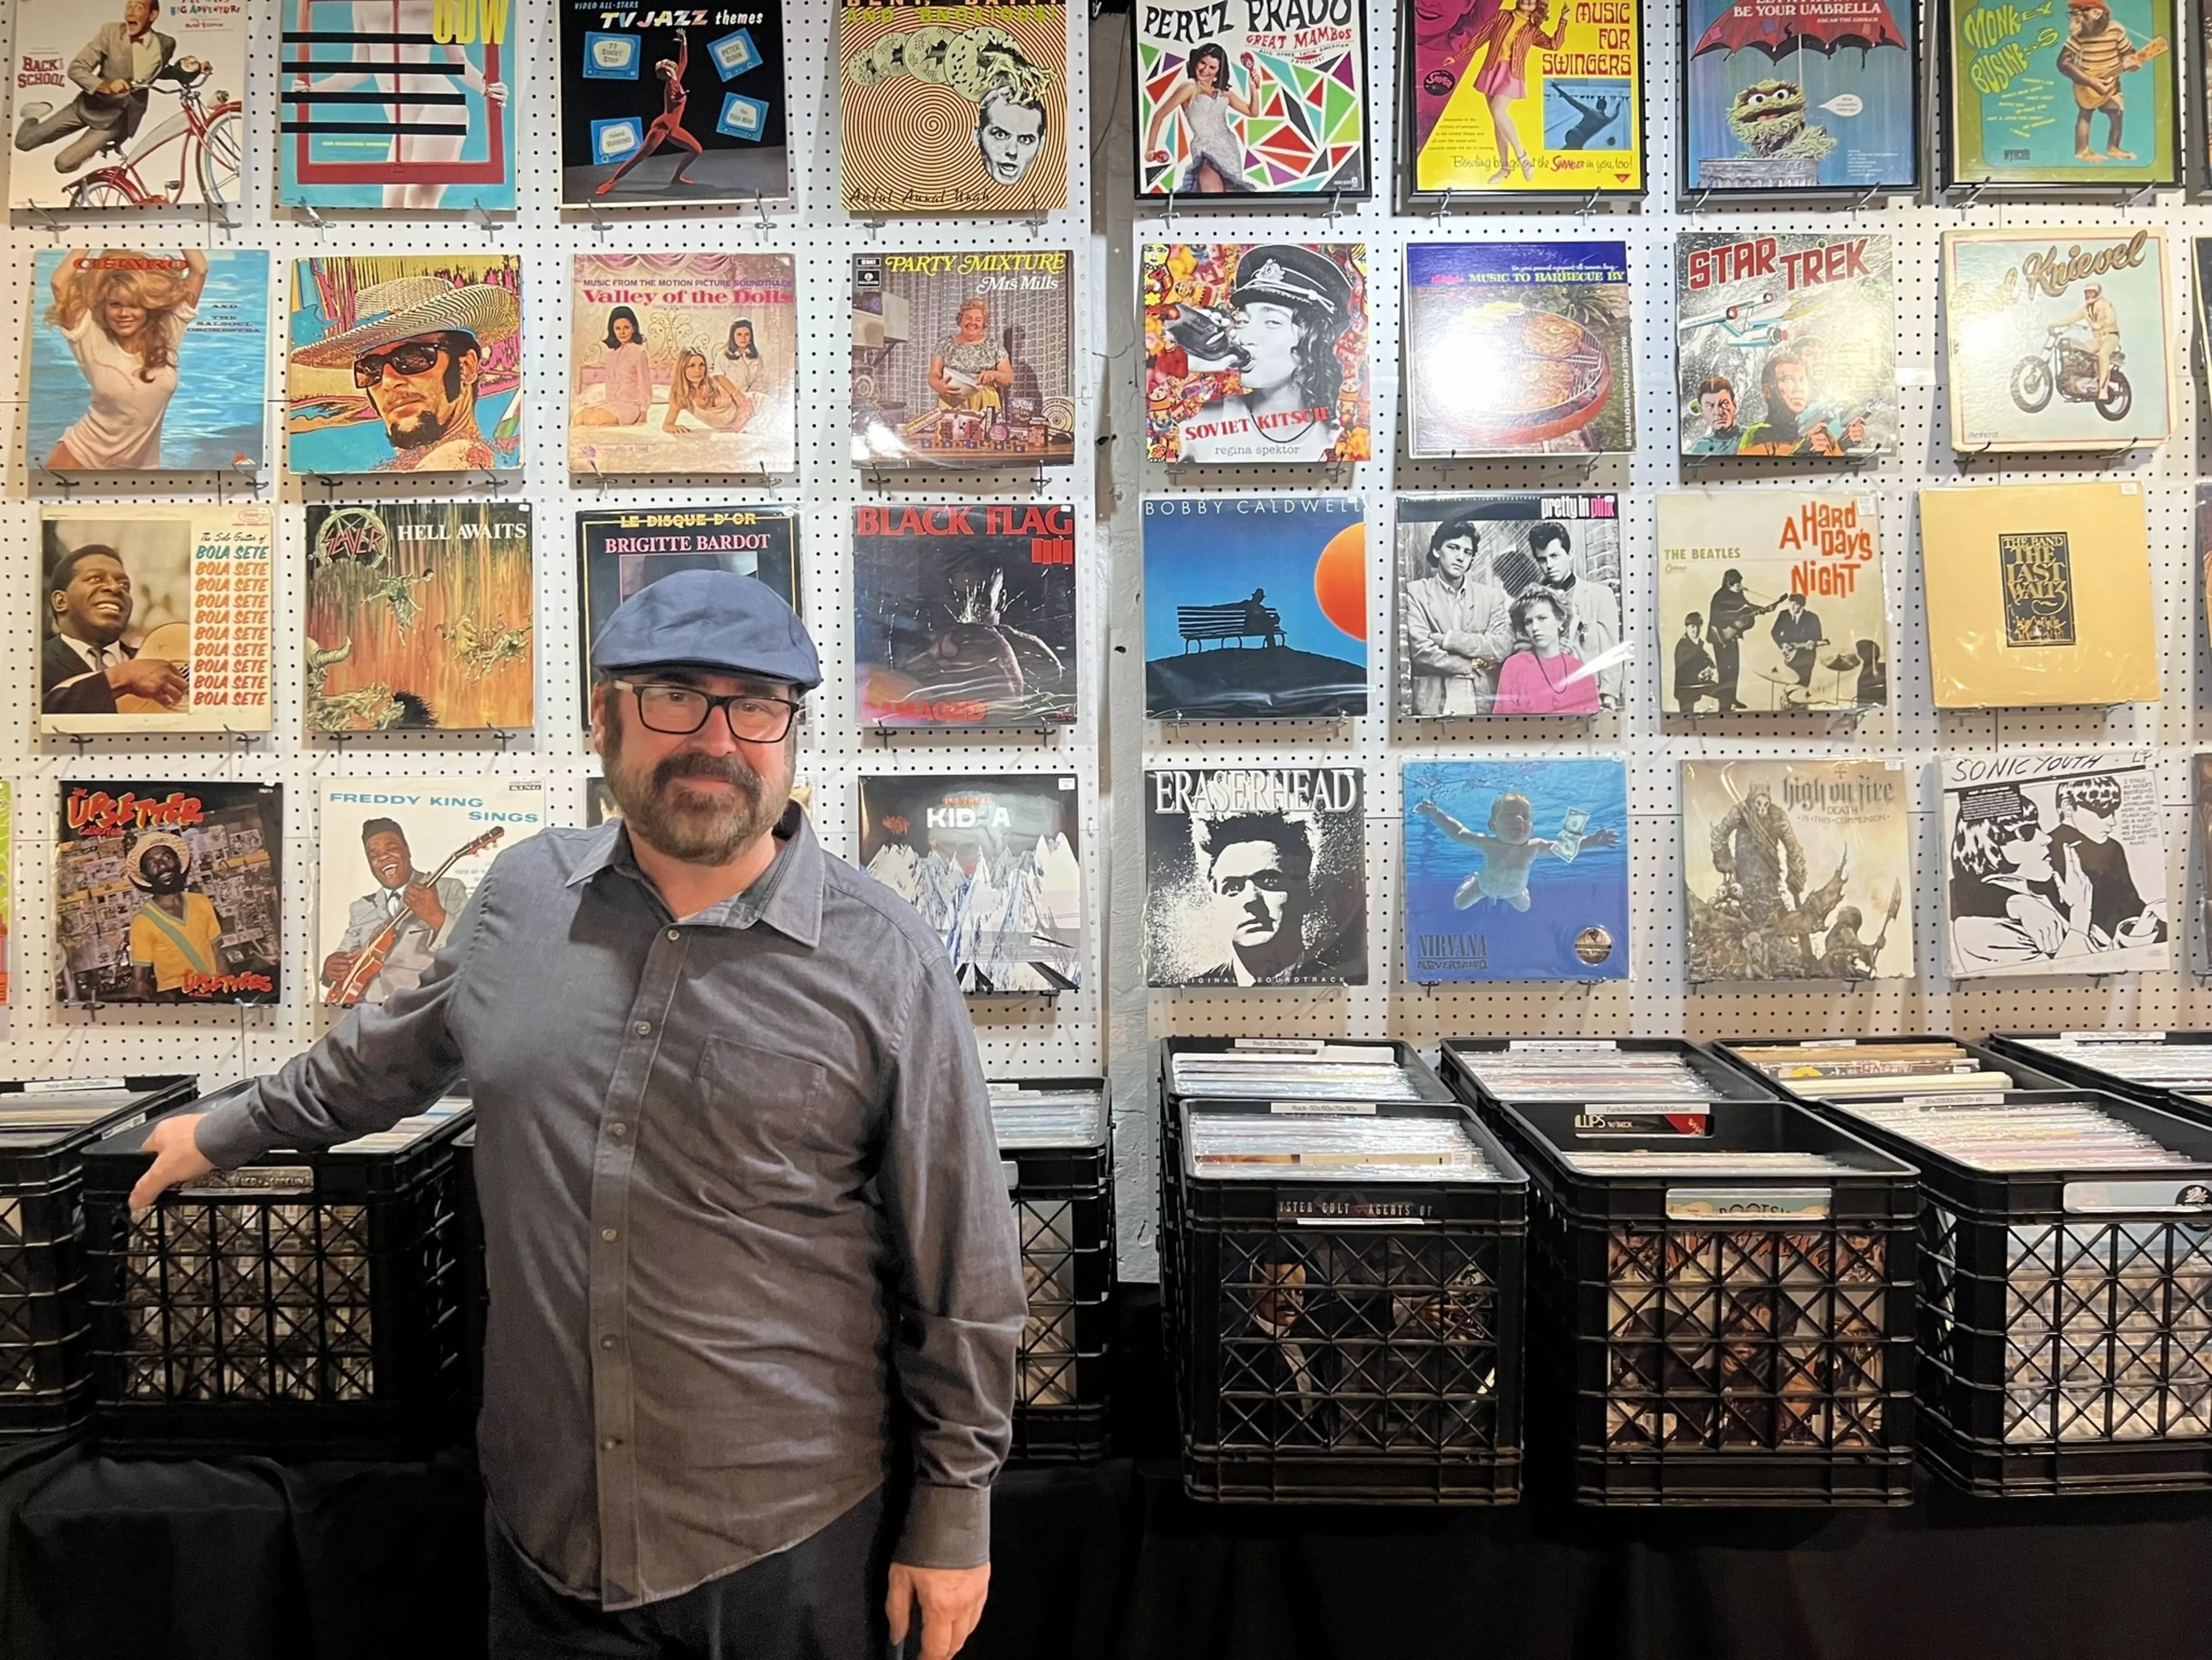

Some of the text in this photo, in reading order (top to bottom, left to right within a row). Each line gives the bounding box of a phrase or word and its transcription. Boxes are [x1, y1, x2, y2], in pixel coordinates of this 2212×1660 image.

[171, 5, 241, 16] BIG ADVENTURE
[600, 9, 763, 28] TV JAZZ themes
[846, 8, 894, 24] AND
[1575, 2, 1630, 24] MUSIC
[1734, 3, 1881, 17] BE YOUR UMBRELLA
[1143, 0, 1351, 44] PEREZ PRADO
[1964, 0, 2053, 48] MONKEY
[1246, 26, 1352, 50] GREAT MAMBOS
[1599, 29, 1630, 50] FOR
[22, 56, 58, 72] BACK
[1543, 54, 1631, 75] SWINGERS
[1971, 27, 2059, 94] BUSINESS
[17, 73, 66, 88] SCHOOL
[1451, 156, 1491, 172] Bowling
[1536, 156, 1550, 168] the
[1586, 157, 1594, 168] in
[1615, 156, 1633, 169] too!
[73, 258, 189, 270] CHARO
[885, 254, 1067, 277] PARTY MIXTURE
[1690, 237, 1872, 292] STAR TREK
[2022, 229, 2148, 301] Knievel
[976, 275, 1059, 294] Mrs Mills
[1469, 273, 1509, 283] MUSIC
[1513, 273, 1531, 282] TO
[1535, 272, 1604, 282] BARBECUE
[1607, 271, 1625, 282] BY
[583, 289, 794, 307] Valley of the Dolls
[1621, 336, 1629, 368] MUSIC
[1185, 407, 1329, 441] SOVIET KITSCH
[1215, 444, 1300, 457] regina spektor
[1146, 499, 1360, 515] BOBBY CALDWELL
[1541, 495, 1615, 519] pretty in pink
[620, 516, 639, 528] LE
[647, 514, 707, 528] DISQUE
[856, 505, 1074, 536] BLACK FLAG
[397, 523, 527, 541] HELL AWAITS
[1779, 516, 1802, 550] A
[321, 525, 385, 560] SLAYER
[605, 534, 771, 553] BRIGITTE BARDOT
[2004, 536, 2064, 549] THE BAND
[195, 546, 269, 559] BOLA SETE
[1664, 547, 1741, 560] THE BEATLES
[2010, 547, 2056, 564] THE
[195, 562, 269, 576] BOLA SETE
[2006, 562, 2066, 583] LAST
[195, 578, 269, 592] BOLA SETE
[195, 595, 268, 608] BOLA SETE
[2007, 581, 2067, 615] WALTZ
[195, 611, 268, 624] BOLA SETE
[194, 627, 268, 640] BOLA SETE
[194, 643, 268, 656] BOLA SETE
[194, 659, 268, 673] BOLA SETE
[194, 676, 267, 689] BOLA SETE
[194, 692, 267, 705] BOLA SETE
[1951, 757, 2032, 782] SONIC
[2033, 754, 2103, 774] YOUTH
[330, 793, 483, 807] FREDDY KING
[1154, 769, 1357, 814] ERASERHEAD
[1783, 775, 1896, 812] high on fire
[67, 791, 205, 829] UPSETTER
[468, 811, 538, 823] SINGS
[926, 807, 1011, 829] KID A
[1827, 806, 1858, 815] DEATH
[78, 826, 123, 835] Collection
[1418, 934, 1488, 957] NIRVANA
[1417, 959, 1488, 970] NEVERMIND
[1323, 1201, 1350, 1214] CULT
[1368, 1203, 1411, 1215] AGENTS
